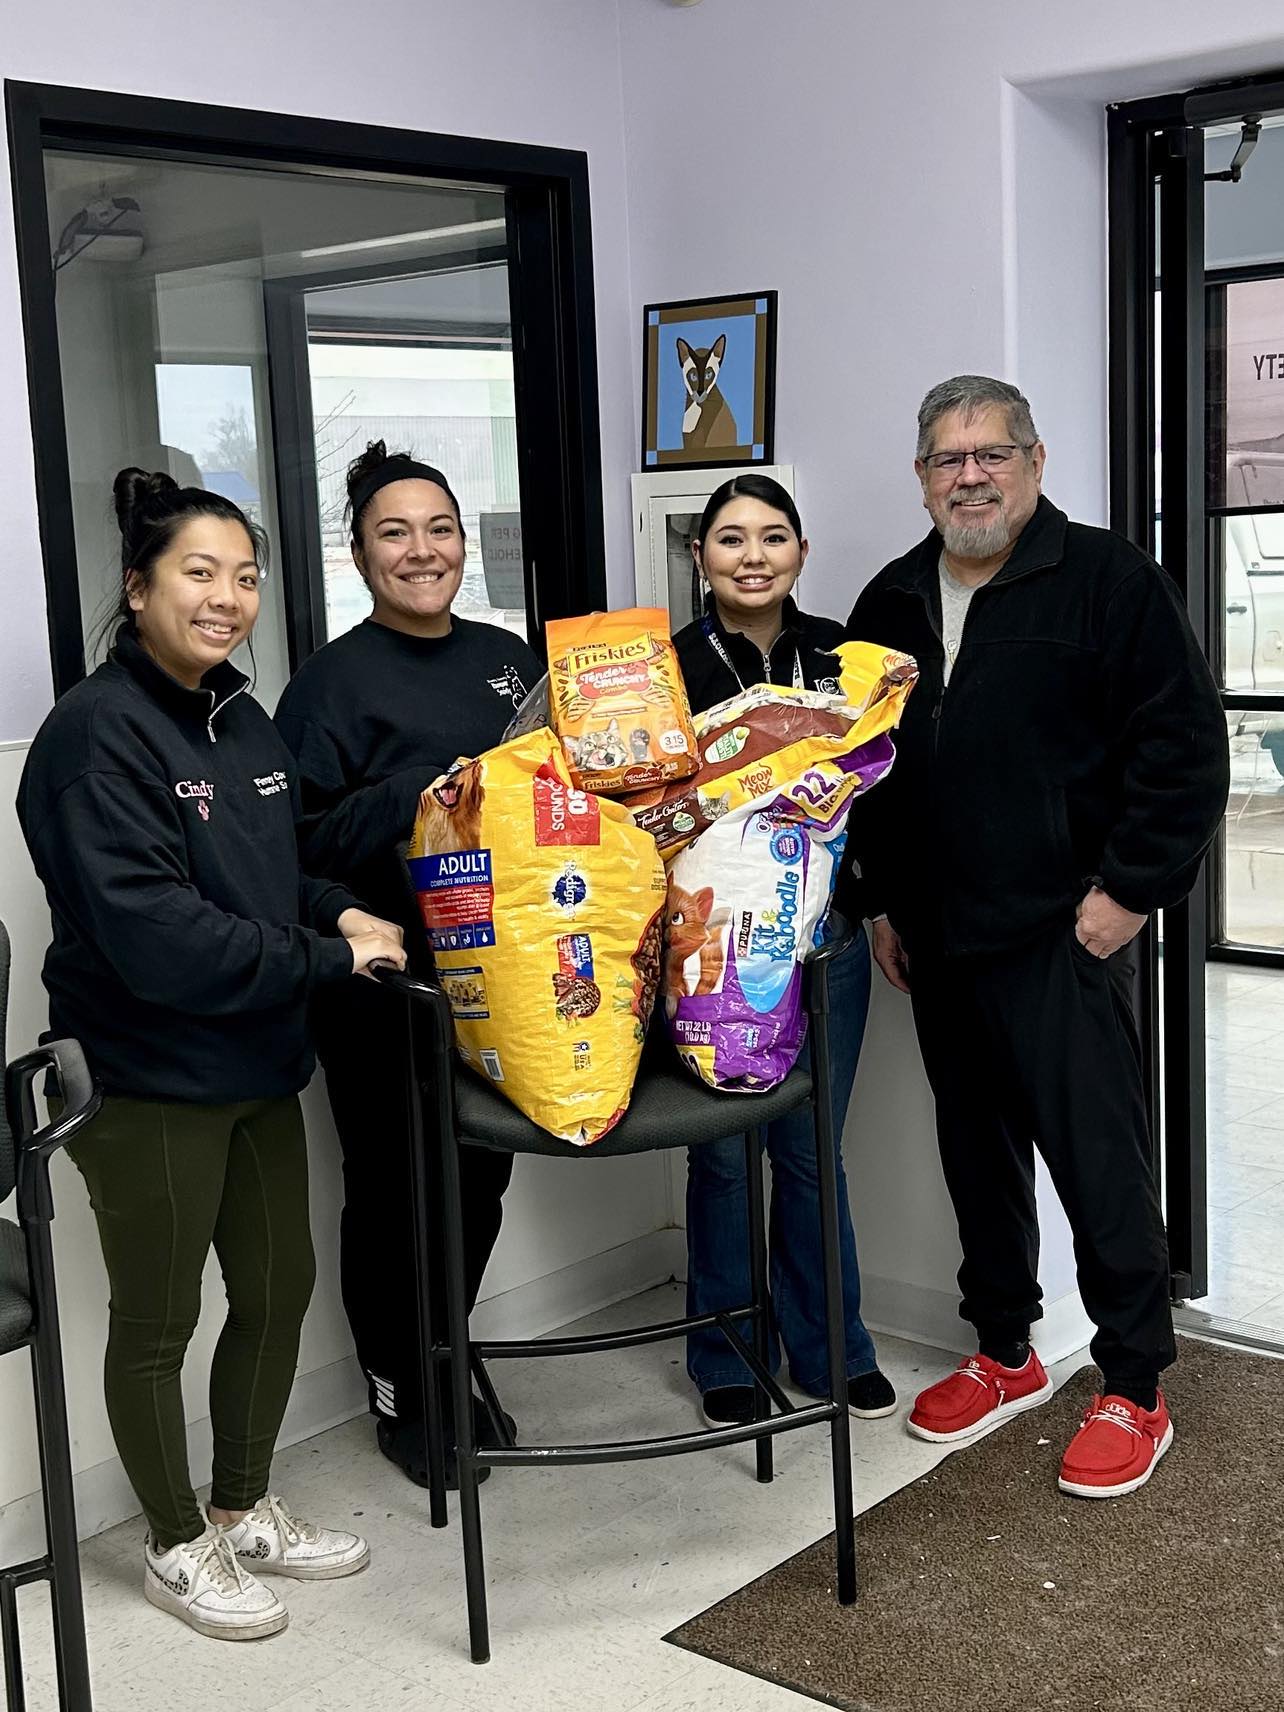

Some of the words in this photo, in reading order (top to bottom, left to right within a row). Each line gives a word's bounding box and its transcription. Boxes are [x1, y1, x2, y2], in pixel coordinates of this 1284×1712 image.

[574, 641, 647, 669] Friskies
[580, 666, 627, 684] Tender
[175, 780, 215, 800] Cindy
[584, 778, 621, 790] Friskies
[737, 763, 772, 792] Meow
[792, 772, 837, 805] 22
[567, 788, 588, 815] 30
[638, 809, 662, 829] Tender
[438, 853, 488, 876] ADULT
[454, 875, 489, 884] NUTRITION
[741, 912, 751, 948] PURINA
[770, 871, 800, 962] Kaboodle
[579, 936, 591, 963] ADULT
[750, 924, 775, 956] Kit
[702, 1022, 712, 1032] LB
